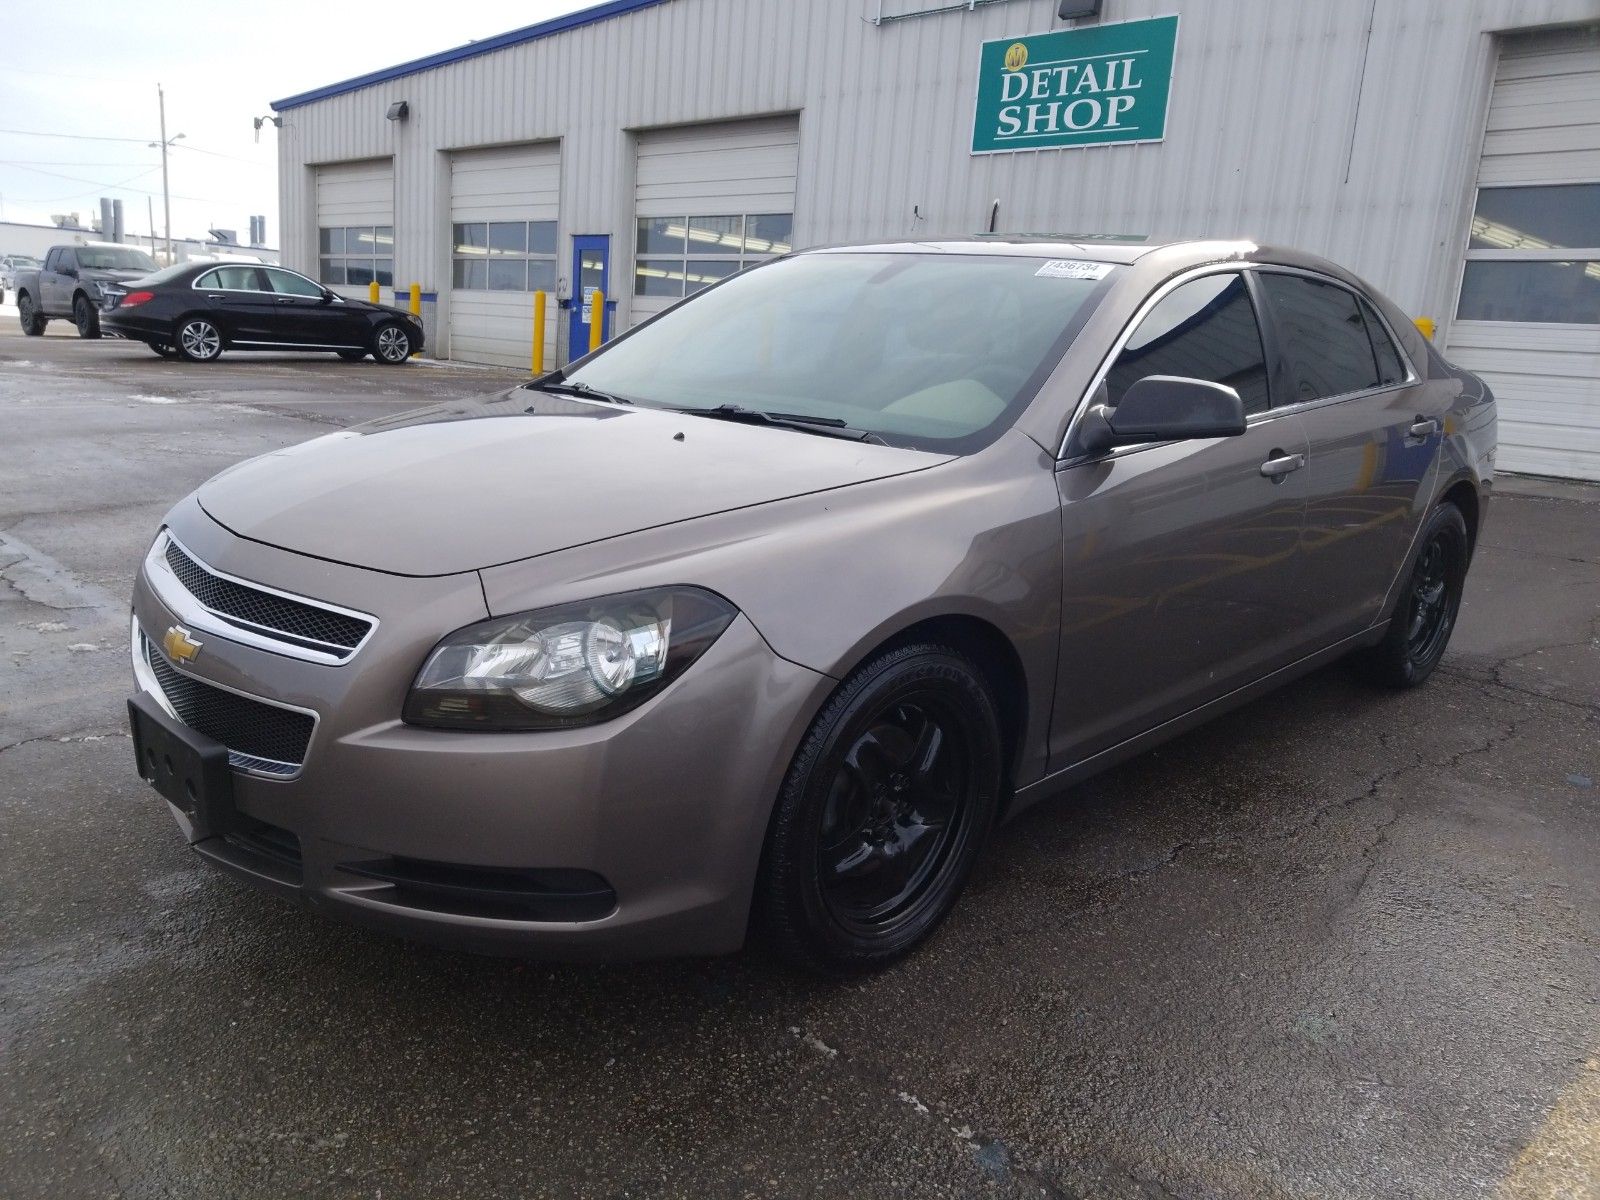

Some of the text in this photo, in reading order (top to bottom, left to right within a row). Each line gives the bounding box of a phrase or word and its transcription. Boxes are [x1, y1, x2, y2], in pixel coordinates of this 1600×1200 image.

[1001, 59, 1142, 102] DETAIL
[997, 96, 1135, 135] SHOP
[1047, 261, 1100, 271] 7436734
